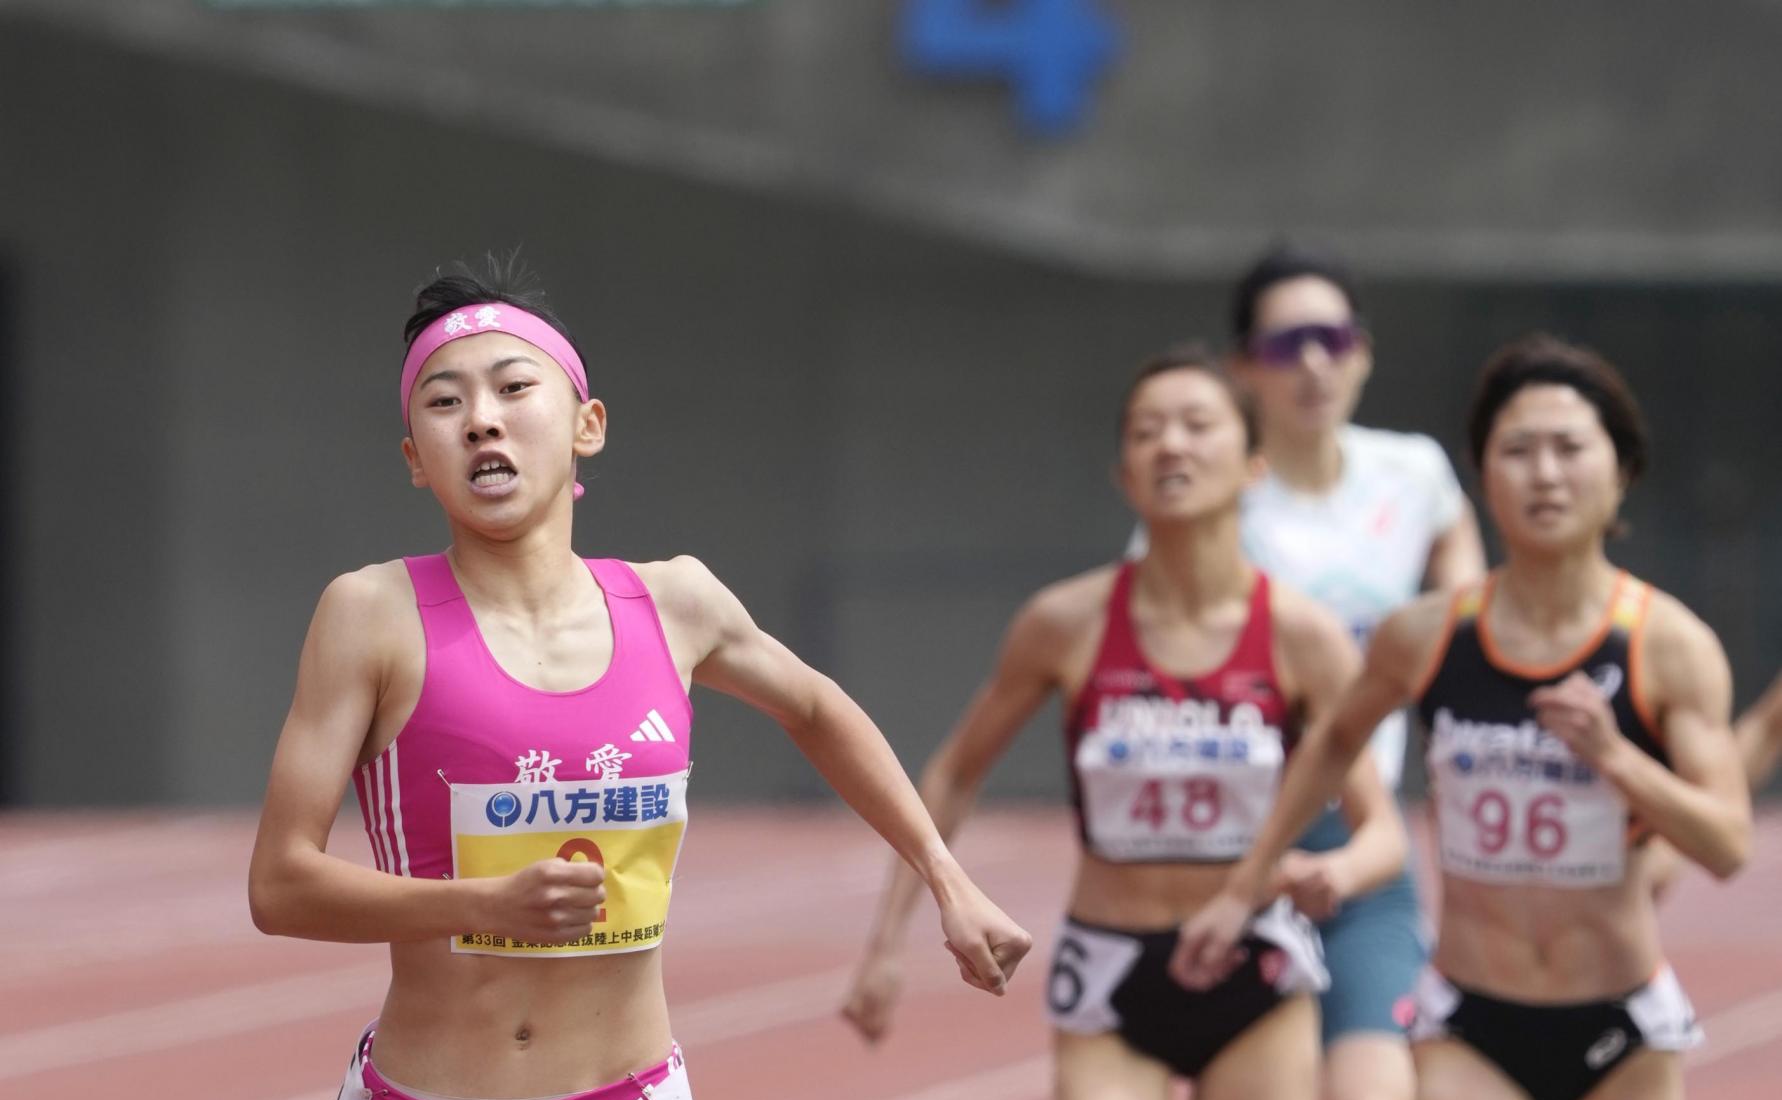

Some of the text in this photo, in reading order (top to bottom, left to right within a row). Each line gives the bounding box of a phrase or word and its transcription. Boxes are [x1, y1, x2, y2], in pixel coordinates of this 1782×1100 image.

[444, 305, 501, 334] 敬愛
[514, 743, 633, 787] 敬愛
[524, 784, 671, 826] 八方建設
[1131, 776, 1222, 832] 48
[1472, 789, 1568, 860] 96
